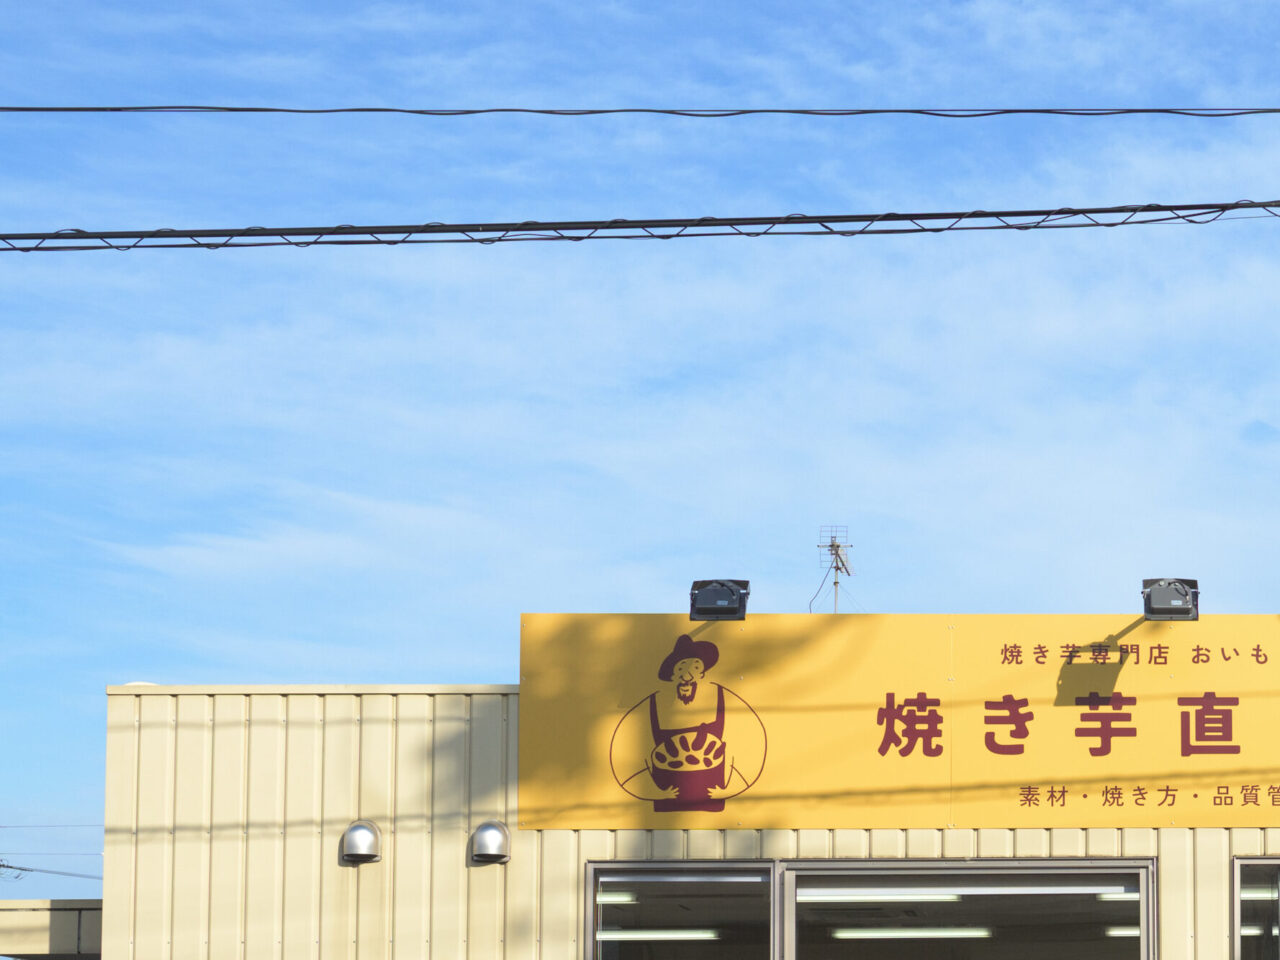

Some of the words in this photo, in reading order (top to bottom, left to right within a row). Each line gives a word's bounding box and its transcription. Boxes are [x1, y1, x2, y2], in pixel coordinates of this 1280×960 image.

[1000, 643, 1170, 665] 焼き芋専門店
